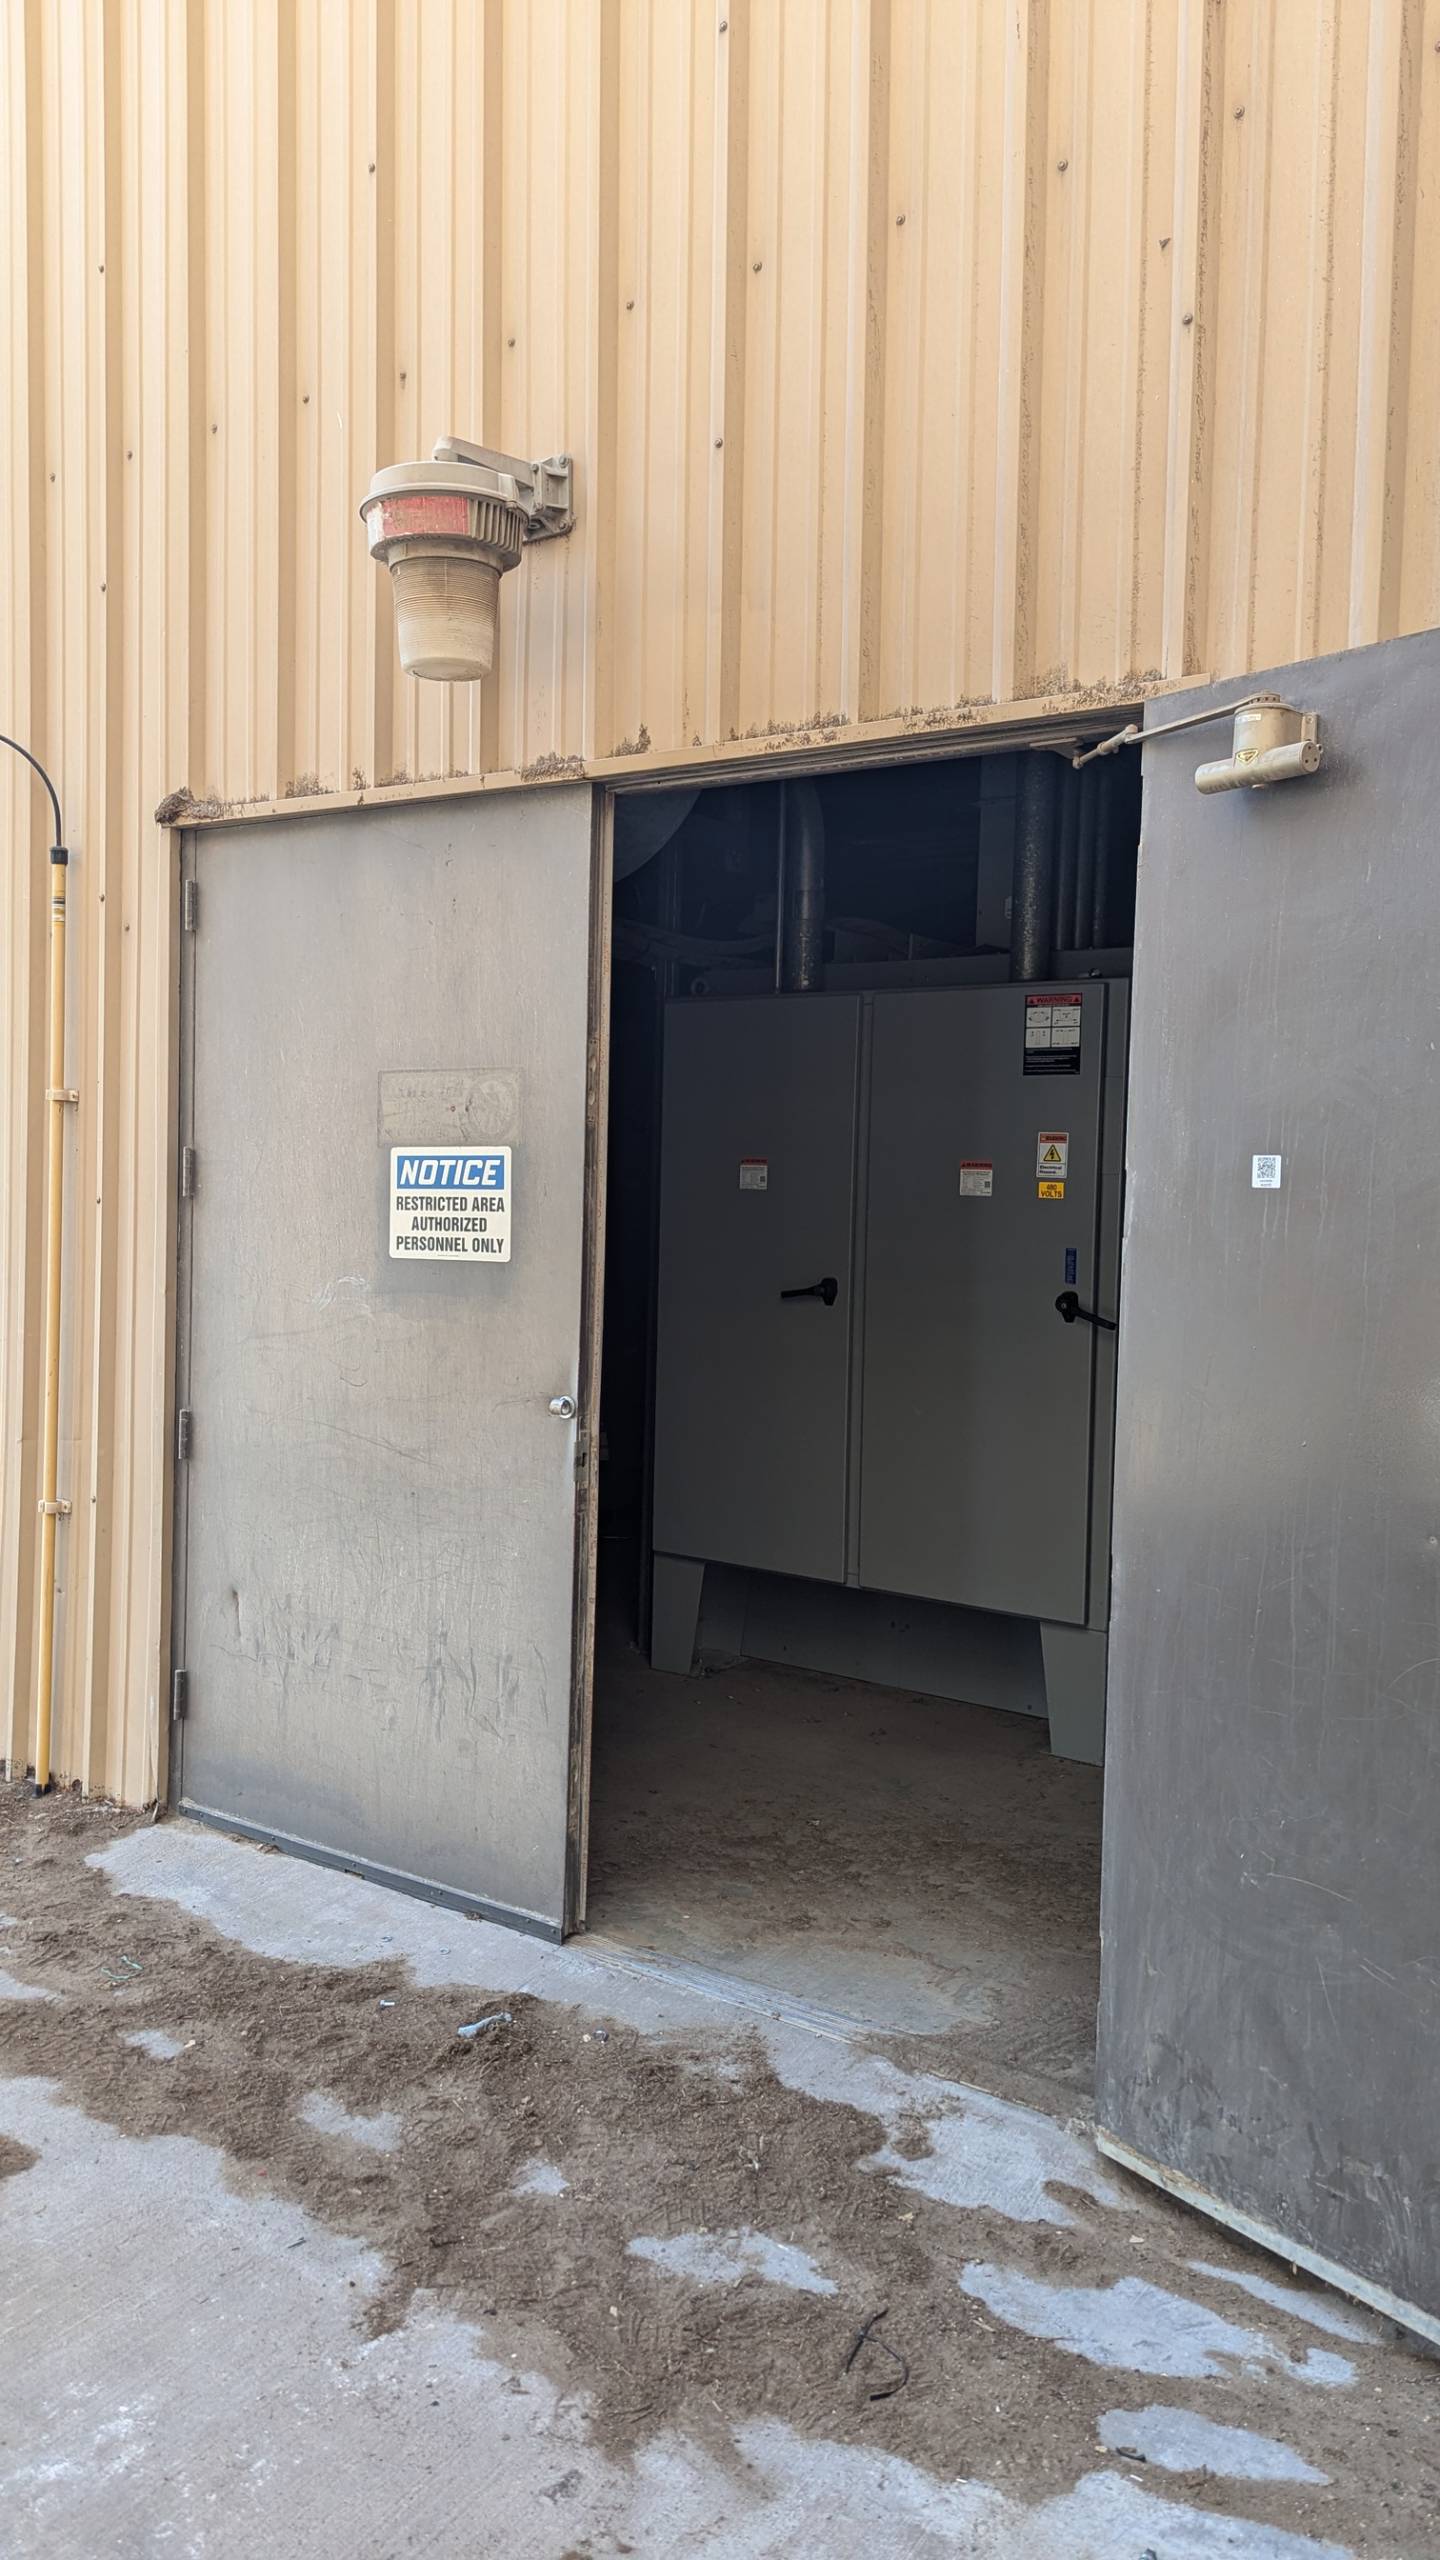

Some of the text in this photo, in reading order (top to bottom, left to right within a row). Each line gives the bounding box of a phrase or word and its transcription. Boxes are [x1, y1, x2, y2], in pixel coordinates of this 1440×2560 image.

[1036, 996, 1072, 1004] WARNING
[399, 1159, 501, 1186] NOTICE
[396, 1196, 505, 1213] RESTRICTED AREA
[411, 1216, 488, 1233] AUTHORIZED
[396, 1236, 504, 1254] PERSONNEL ONLY
